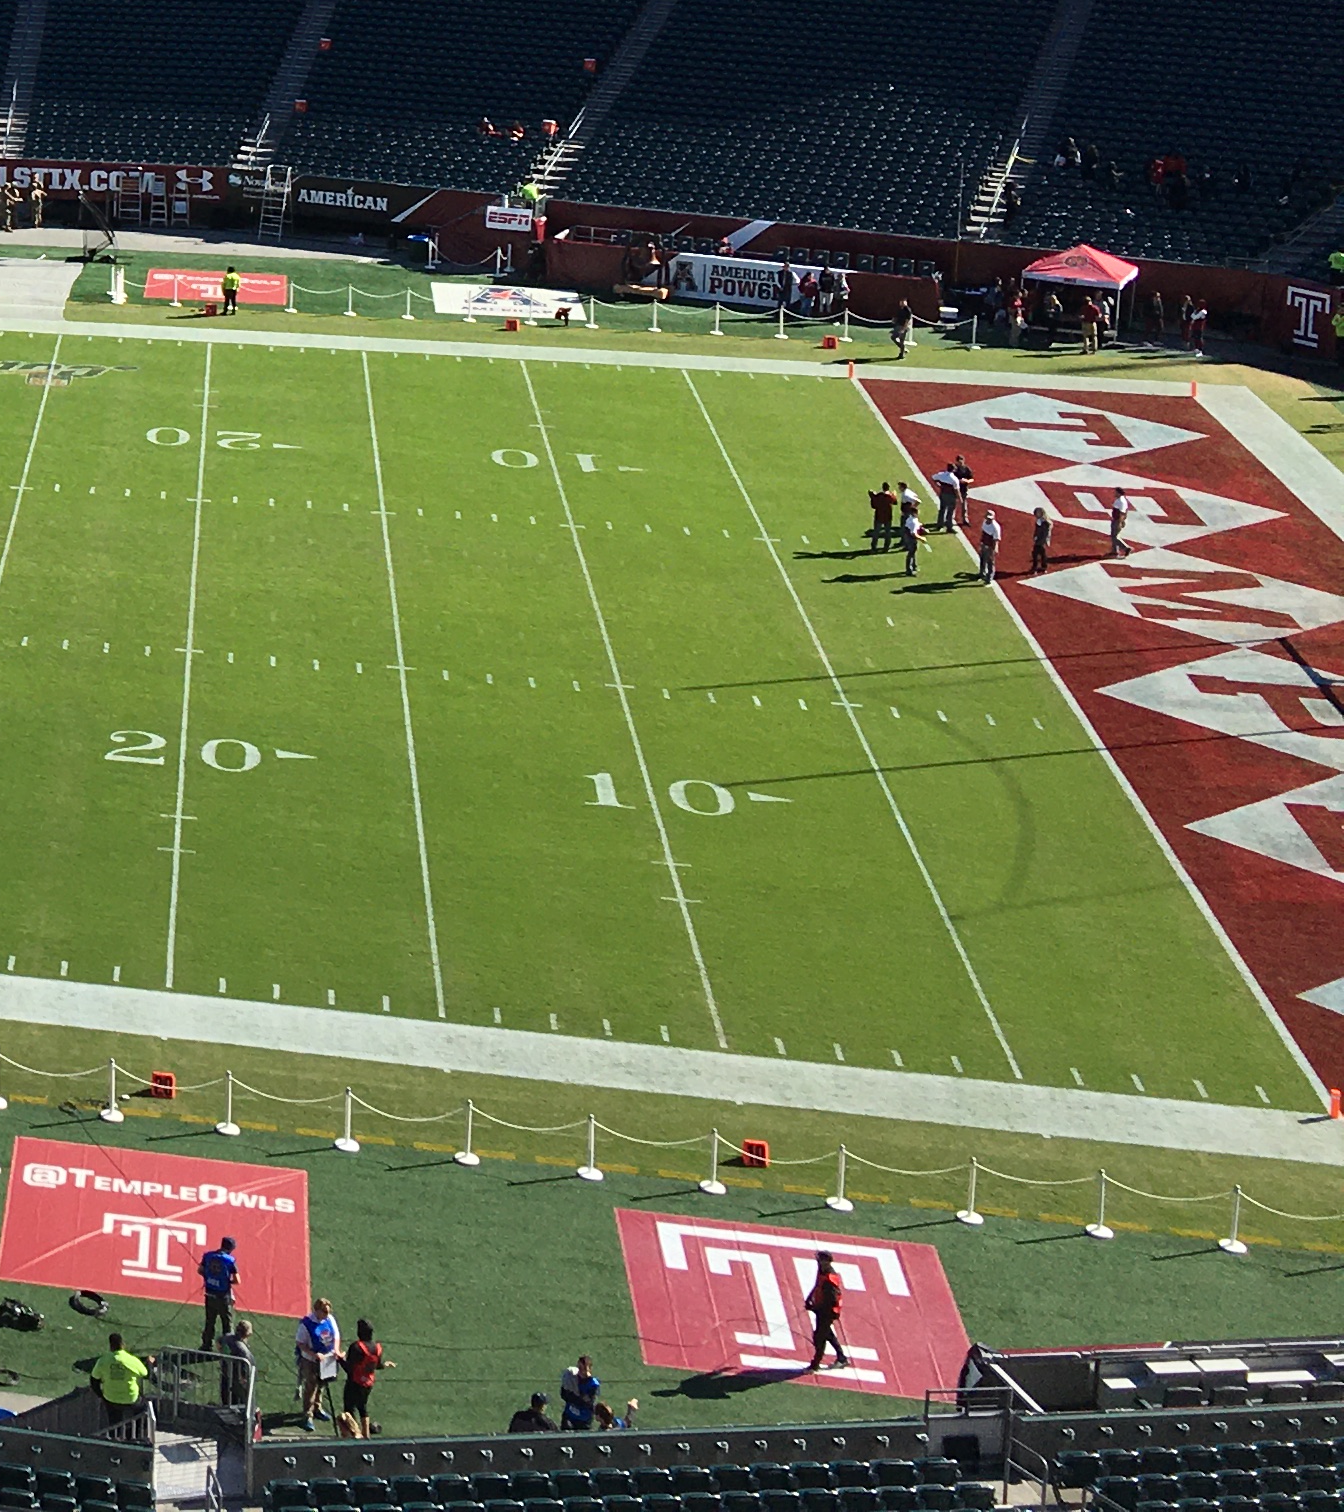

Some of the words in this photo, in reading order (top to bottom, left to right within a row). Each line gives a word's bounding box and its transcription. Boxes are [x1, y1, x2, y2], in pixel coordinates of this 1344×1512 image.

[298, 190, 388, 211] AMERICAN
[488, 211, 530, 226] ESPN
[1286, 286, 1331, 348] T
[103, 728, 264, 775] 20
[583, 770, 736, 818] 10
[102, 1212, 208, 1283] T
[655, 1220, 911, 1384] T
